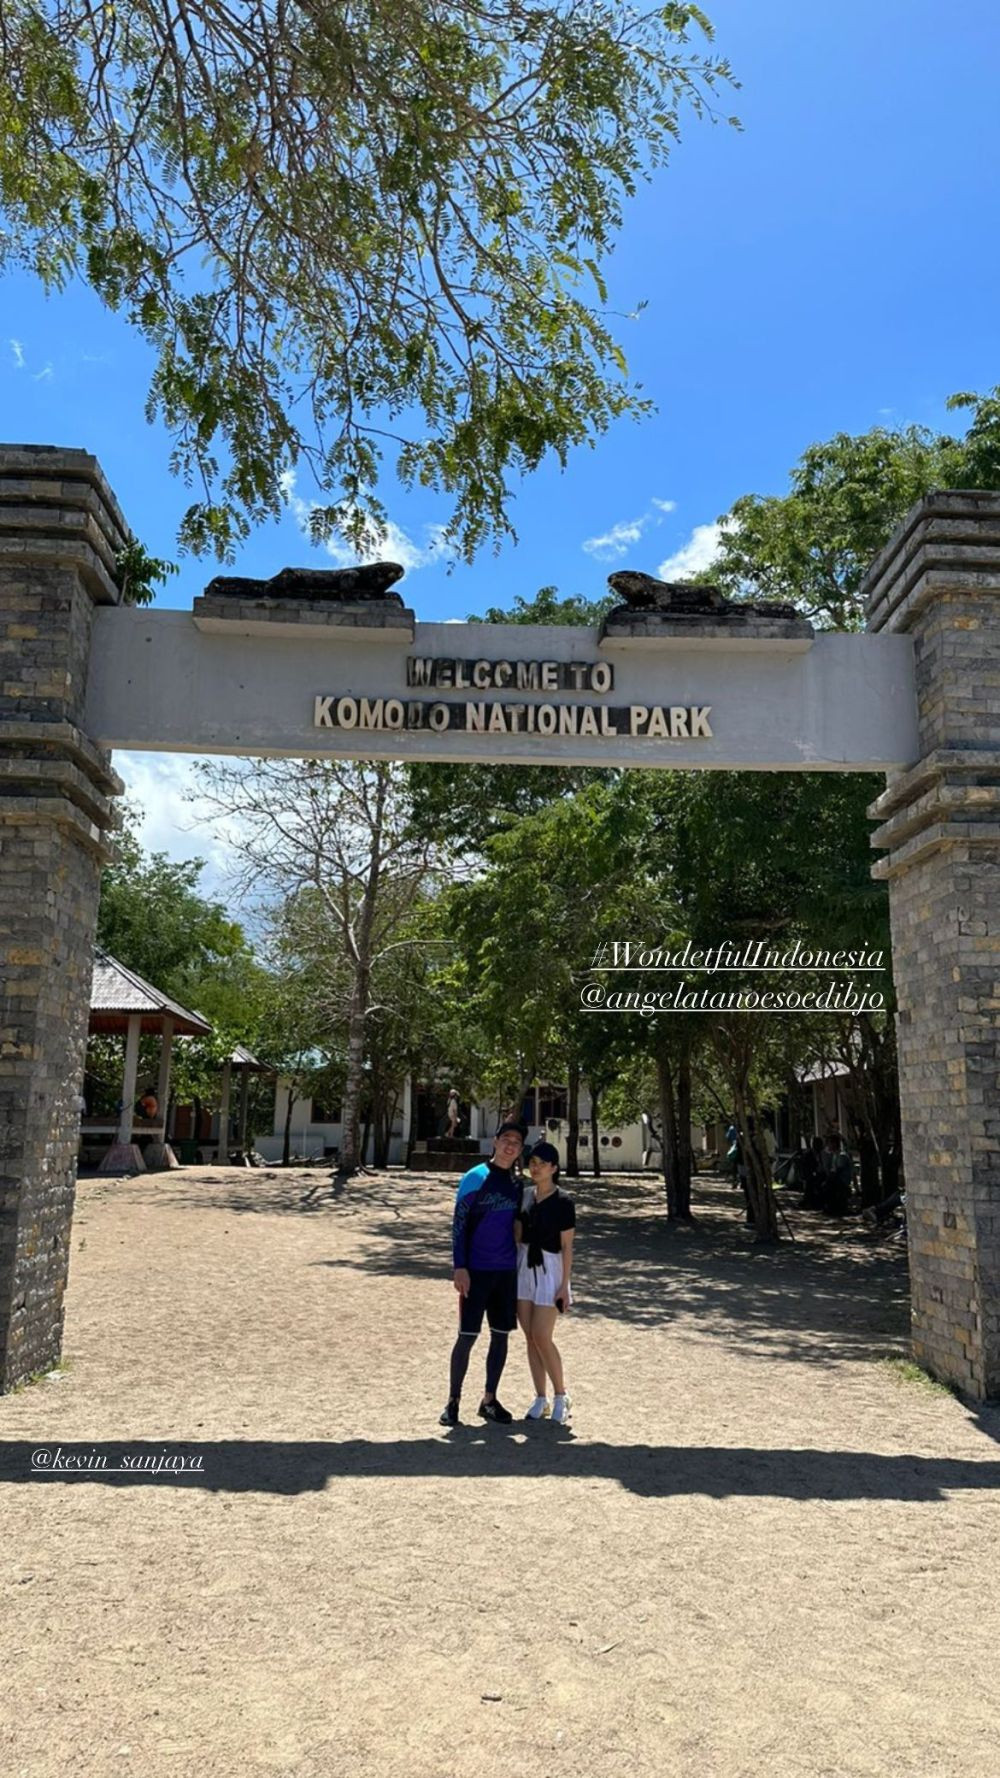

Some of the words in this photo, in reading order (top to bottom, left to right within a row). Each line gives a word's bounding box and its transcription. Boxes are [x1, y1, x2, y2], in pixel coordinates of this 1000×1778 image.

[407, 656, 559, 691] WELCOME
[571, 660, 612, 693] TO
[465, 702, 617, 737] NATIONAL
[630, 706, 713, 738] PARK
